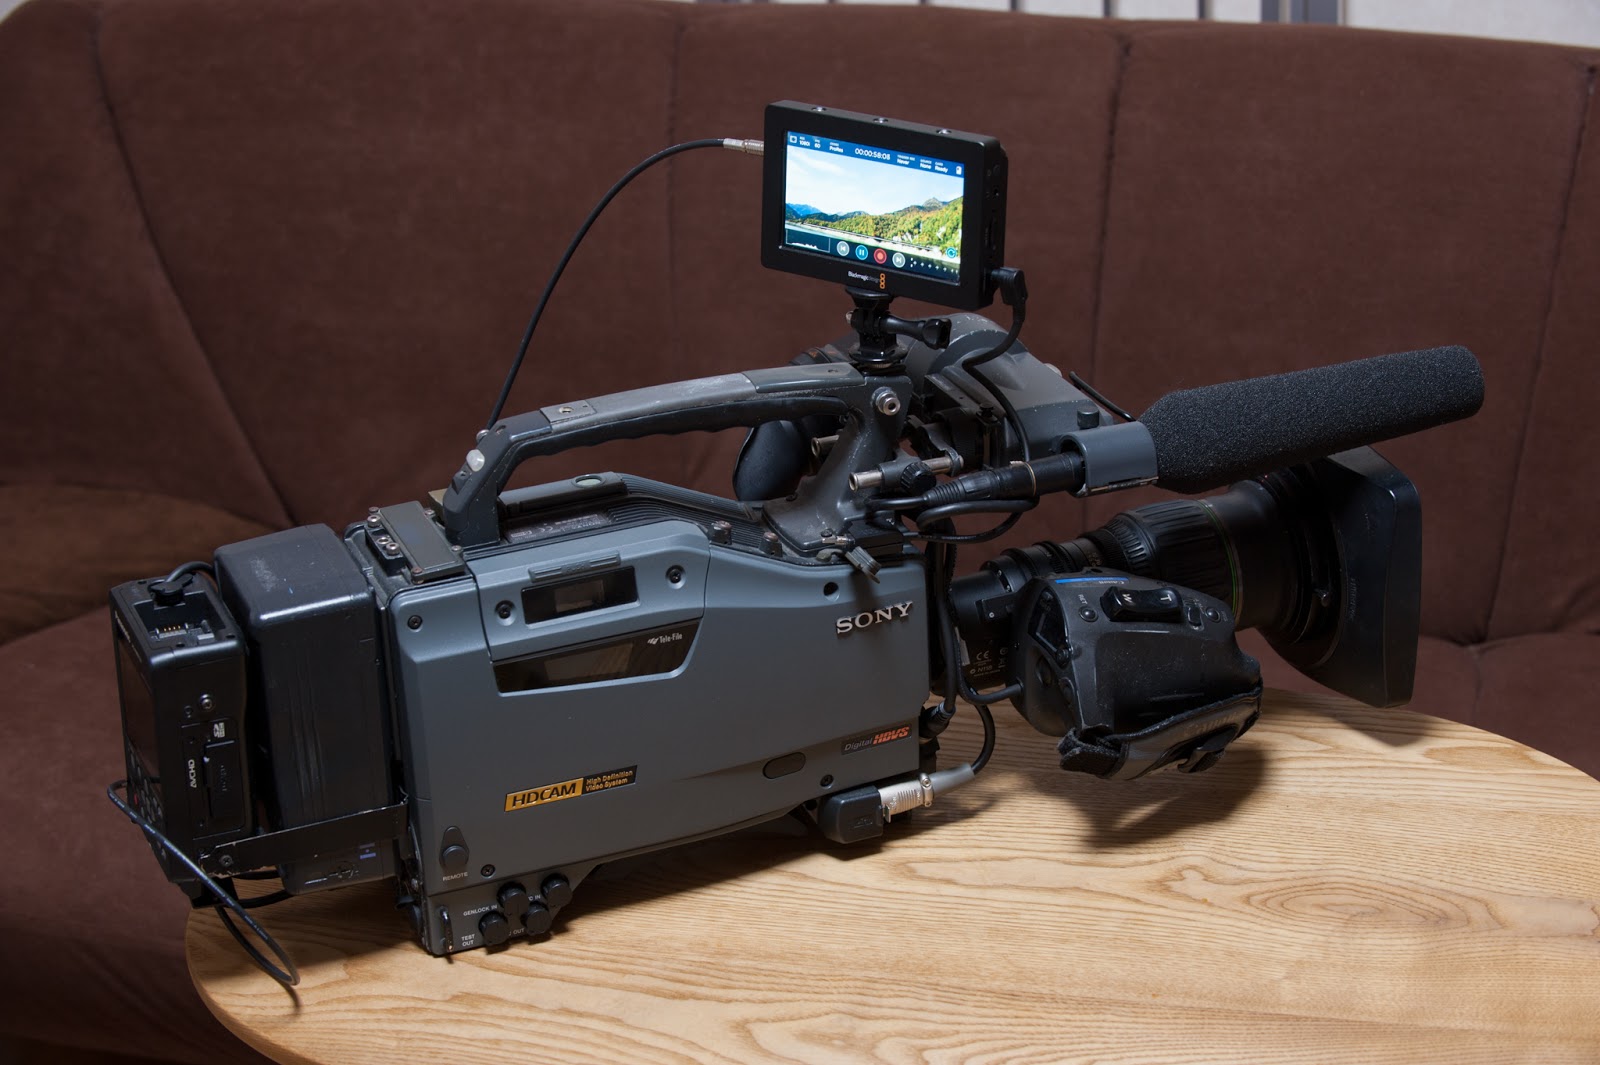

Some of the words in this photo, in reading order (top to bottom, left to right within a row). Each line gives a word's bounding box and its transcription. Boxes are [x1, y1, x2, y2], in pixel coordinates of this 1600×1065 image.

[1077, 594, 1088, 605] RET
[1160, 593, 1173, 603] T
[835, 600, 914, 634] SONY
[659, 632, 683, 644] Tele-File
[872, 726, 910, 745] HDVS
[844, 737, 873, 751] Digital
[187, 759, 198, 788] AVCHD
[586, 776, 602, 786] High
[602, 770, 634, 783] Definition
[585, 783, 604, 792] Video
[604, 777, 628, 790] System
[511, 782, 577, 807] HDCAM
[442, 871, 469, 881] REMOTE
[463, 906, 490, 917] GENLOCK
[513, 927, 525, 935] OUT
[462, 939, 474, 947] OUT
